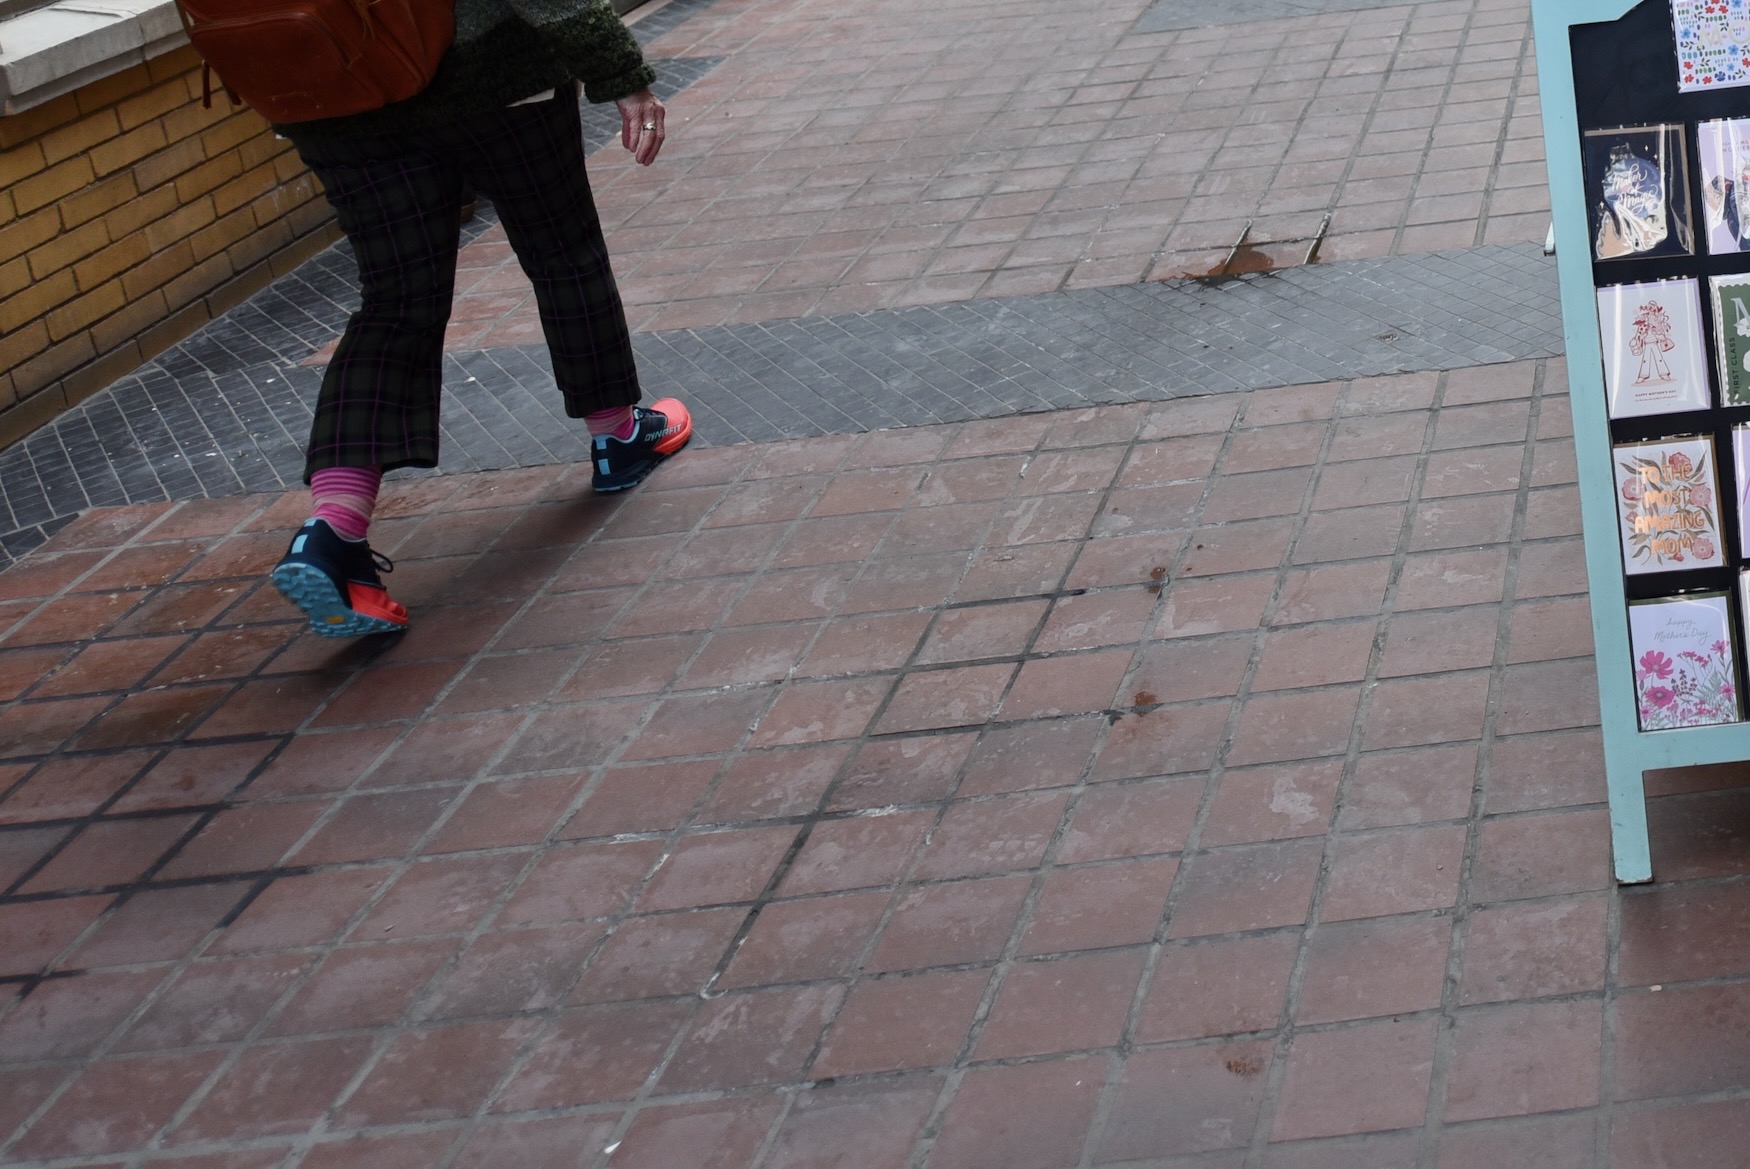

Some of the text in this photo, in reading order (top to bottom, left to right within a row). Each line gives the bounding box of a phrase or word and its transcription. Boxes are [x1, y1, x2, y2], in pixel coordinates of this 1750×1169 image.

[1729, 337, 1738, 366] CLASS
[644, 423, 682, 442] DYNAFIT
[1639, 463, 1693, 485] TO THE
[1644, 488, 1688, 509] MOST
[1635, 511, 1705, 535] AMAZING
[1650, 535, 1693, 555] MOM
[1665, 618, 1697, 630] happy
